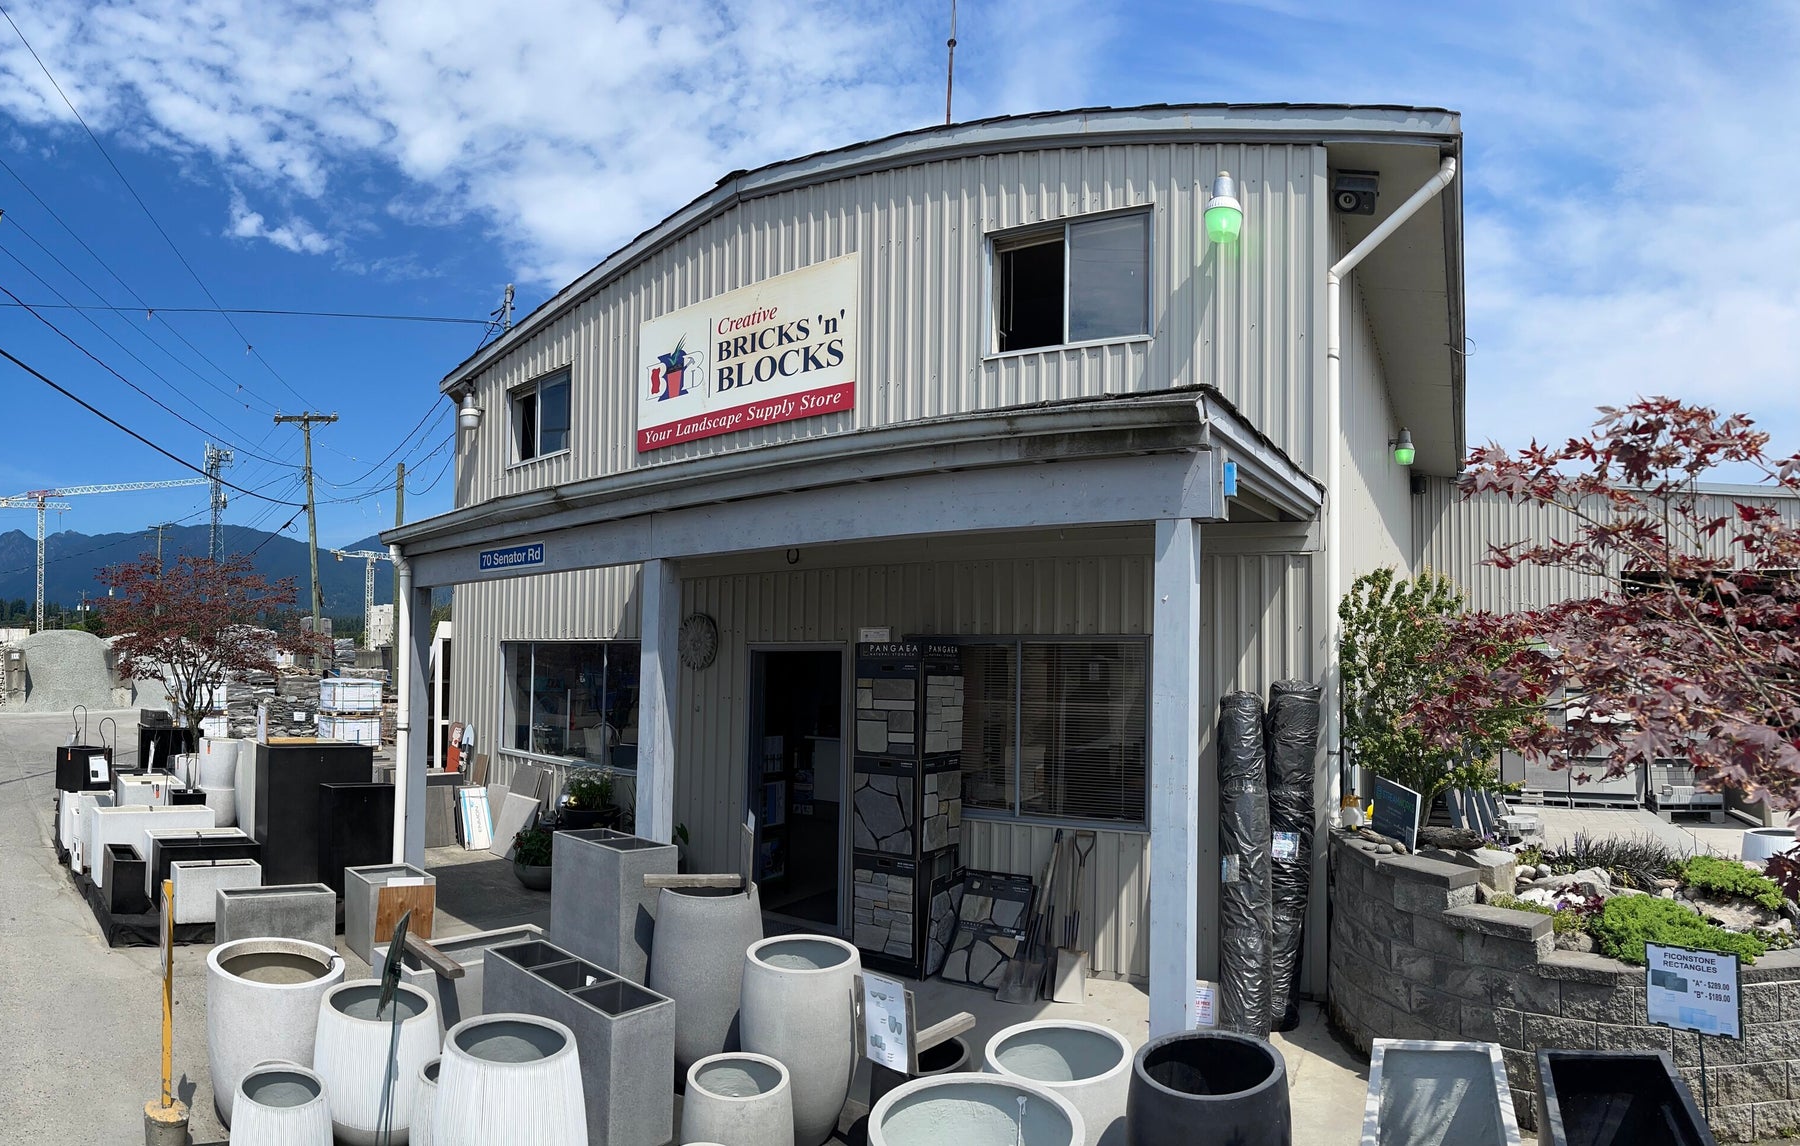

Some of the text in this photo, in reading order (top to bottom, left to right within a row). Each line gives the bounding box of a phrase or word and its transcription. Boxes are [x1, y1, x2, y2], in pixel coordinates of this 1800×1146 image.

[717, 306, 778, 335] Creative
[717, 318, 810, 362] BRICKS
[716, 338, 845, 393] BLOCKS
[645, 392, 842, 444] Your Landscape Supply Store
[482, 546, 541, 567] 70 Senator Rd
[869, 644, 918, 653] PANGAEA
[928, 645, 958, 654] PANGAEA
[1662, 960, 1718, 974] RECTANGLES
[1663, 952, 1716, 966] FICONSTONE
